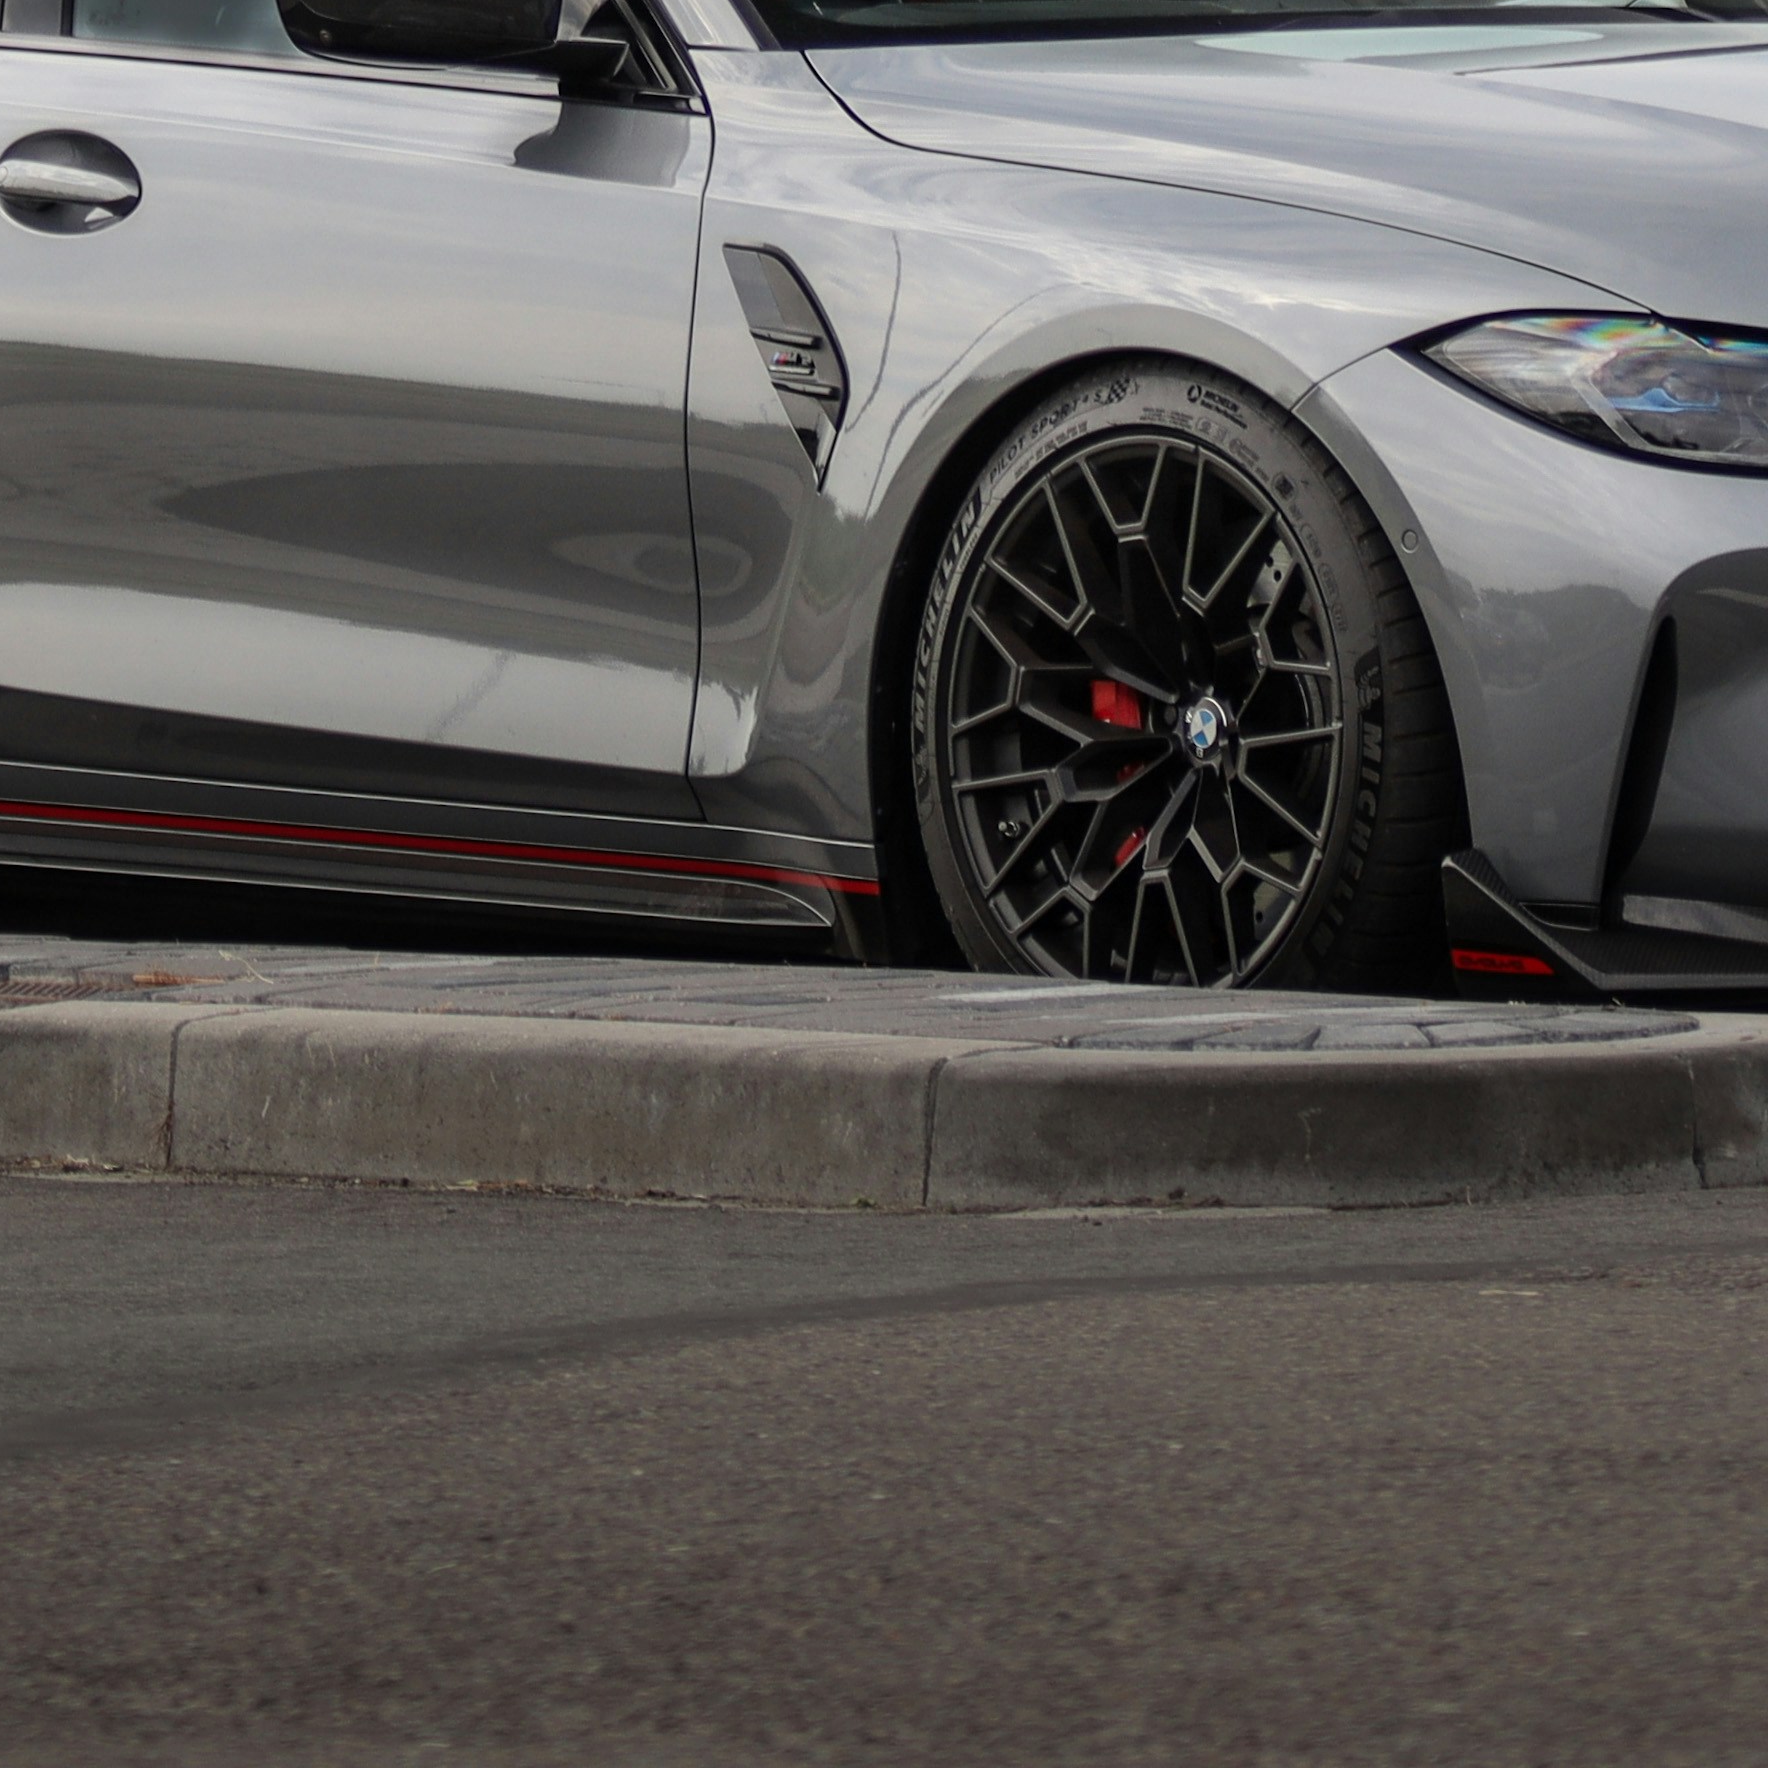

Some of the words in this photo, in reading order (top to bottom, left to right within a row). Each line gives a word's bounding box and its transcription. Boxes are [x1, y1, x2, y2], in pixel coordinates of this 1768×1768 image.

[989, 435, 1026, 484] PILOT
[1032, 398, 1081, 439] SPORT
[915, 500, 976, 734] MICHELIN
[1309, 720, 1383, 959] MICHELIN
